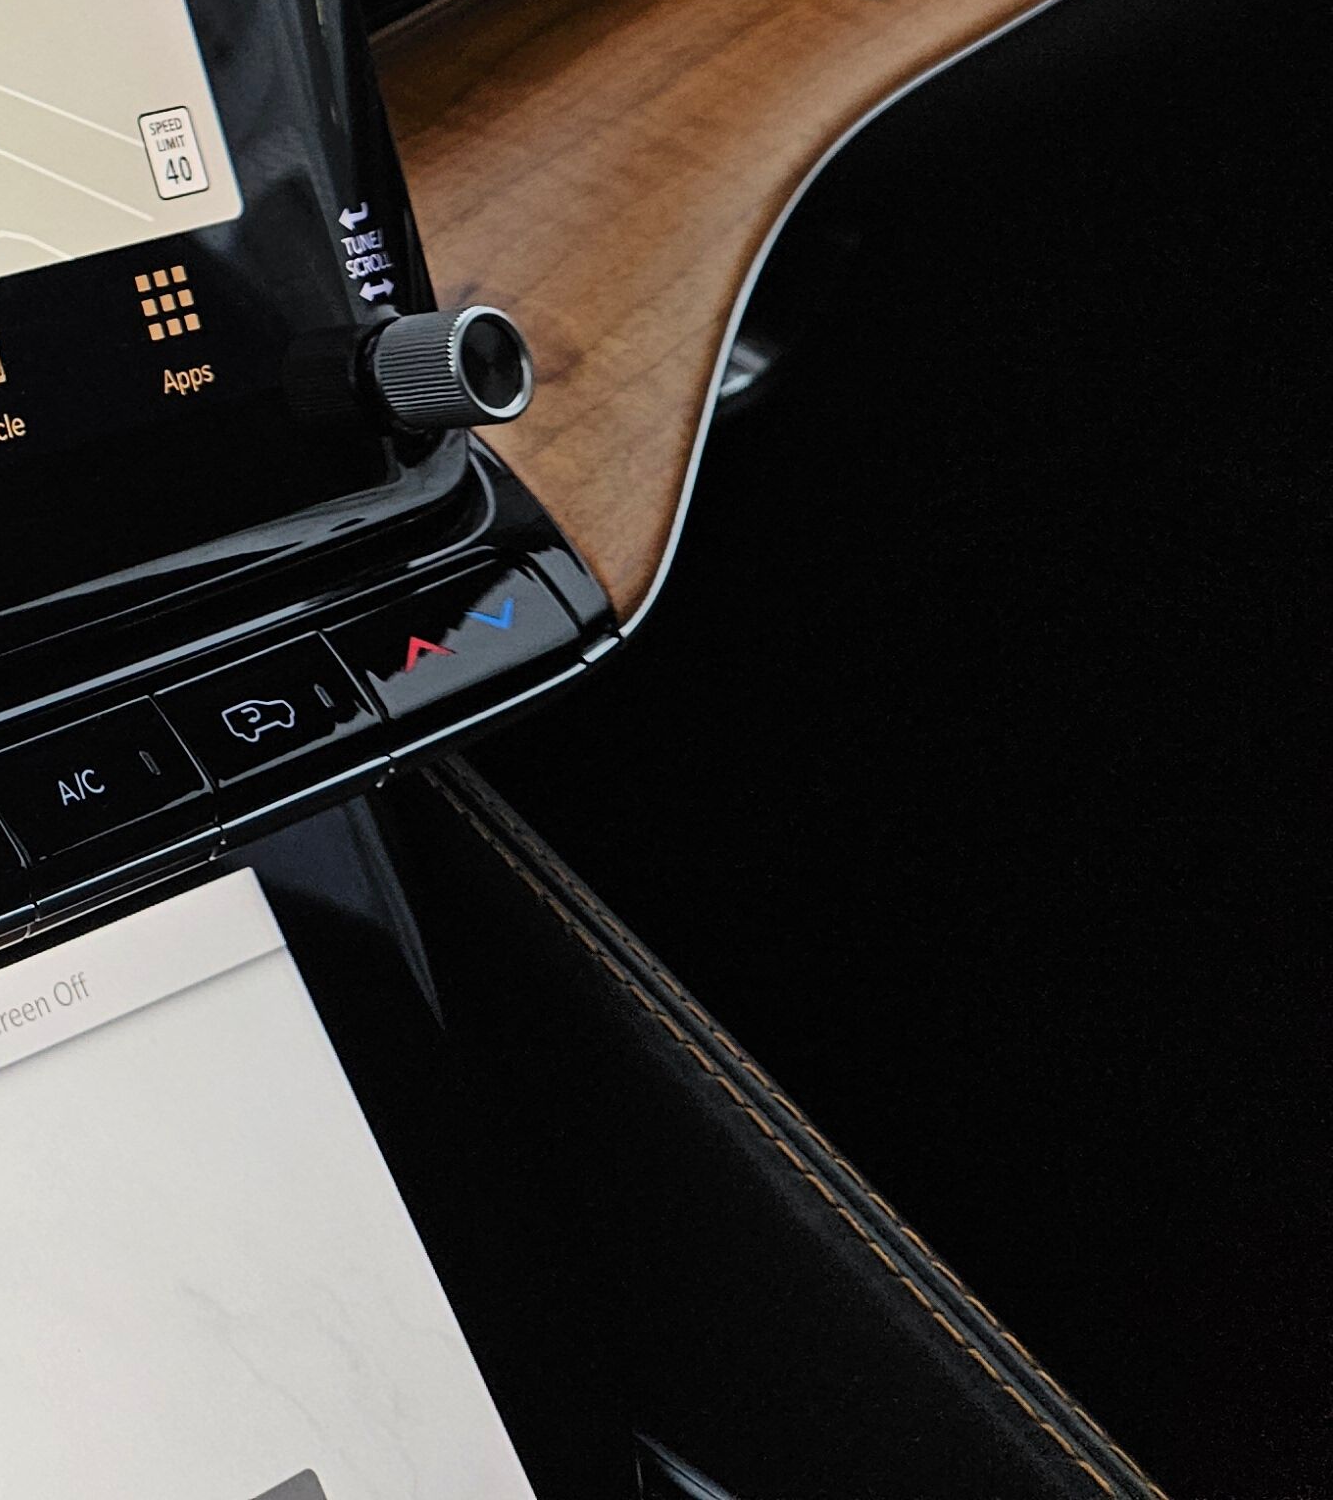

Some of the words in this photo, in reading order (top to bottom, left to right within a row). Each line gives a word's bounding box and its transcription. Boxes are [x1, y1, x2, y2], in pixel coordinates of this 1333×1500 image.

[149, 117, 182, 136] SPEED
[156, 134, 185, 152] LIMIT
[166, 156, 192, 184] 40
[162, 361, 215, 396] Apps
[57, 768, 106, 805] A/C
[53, 973, 91, 1007] Off
